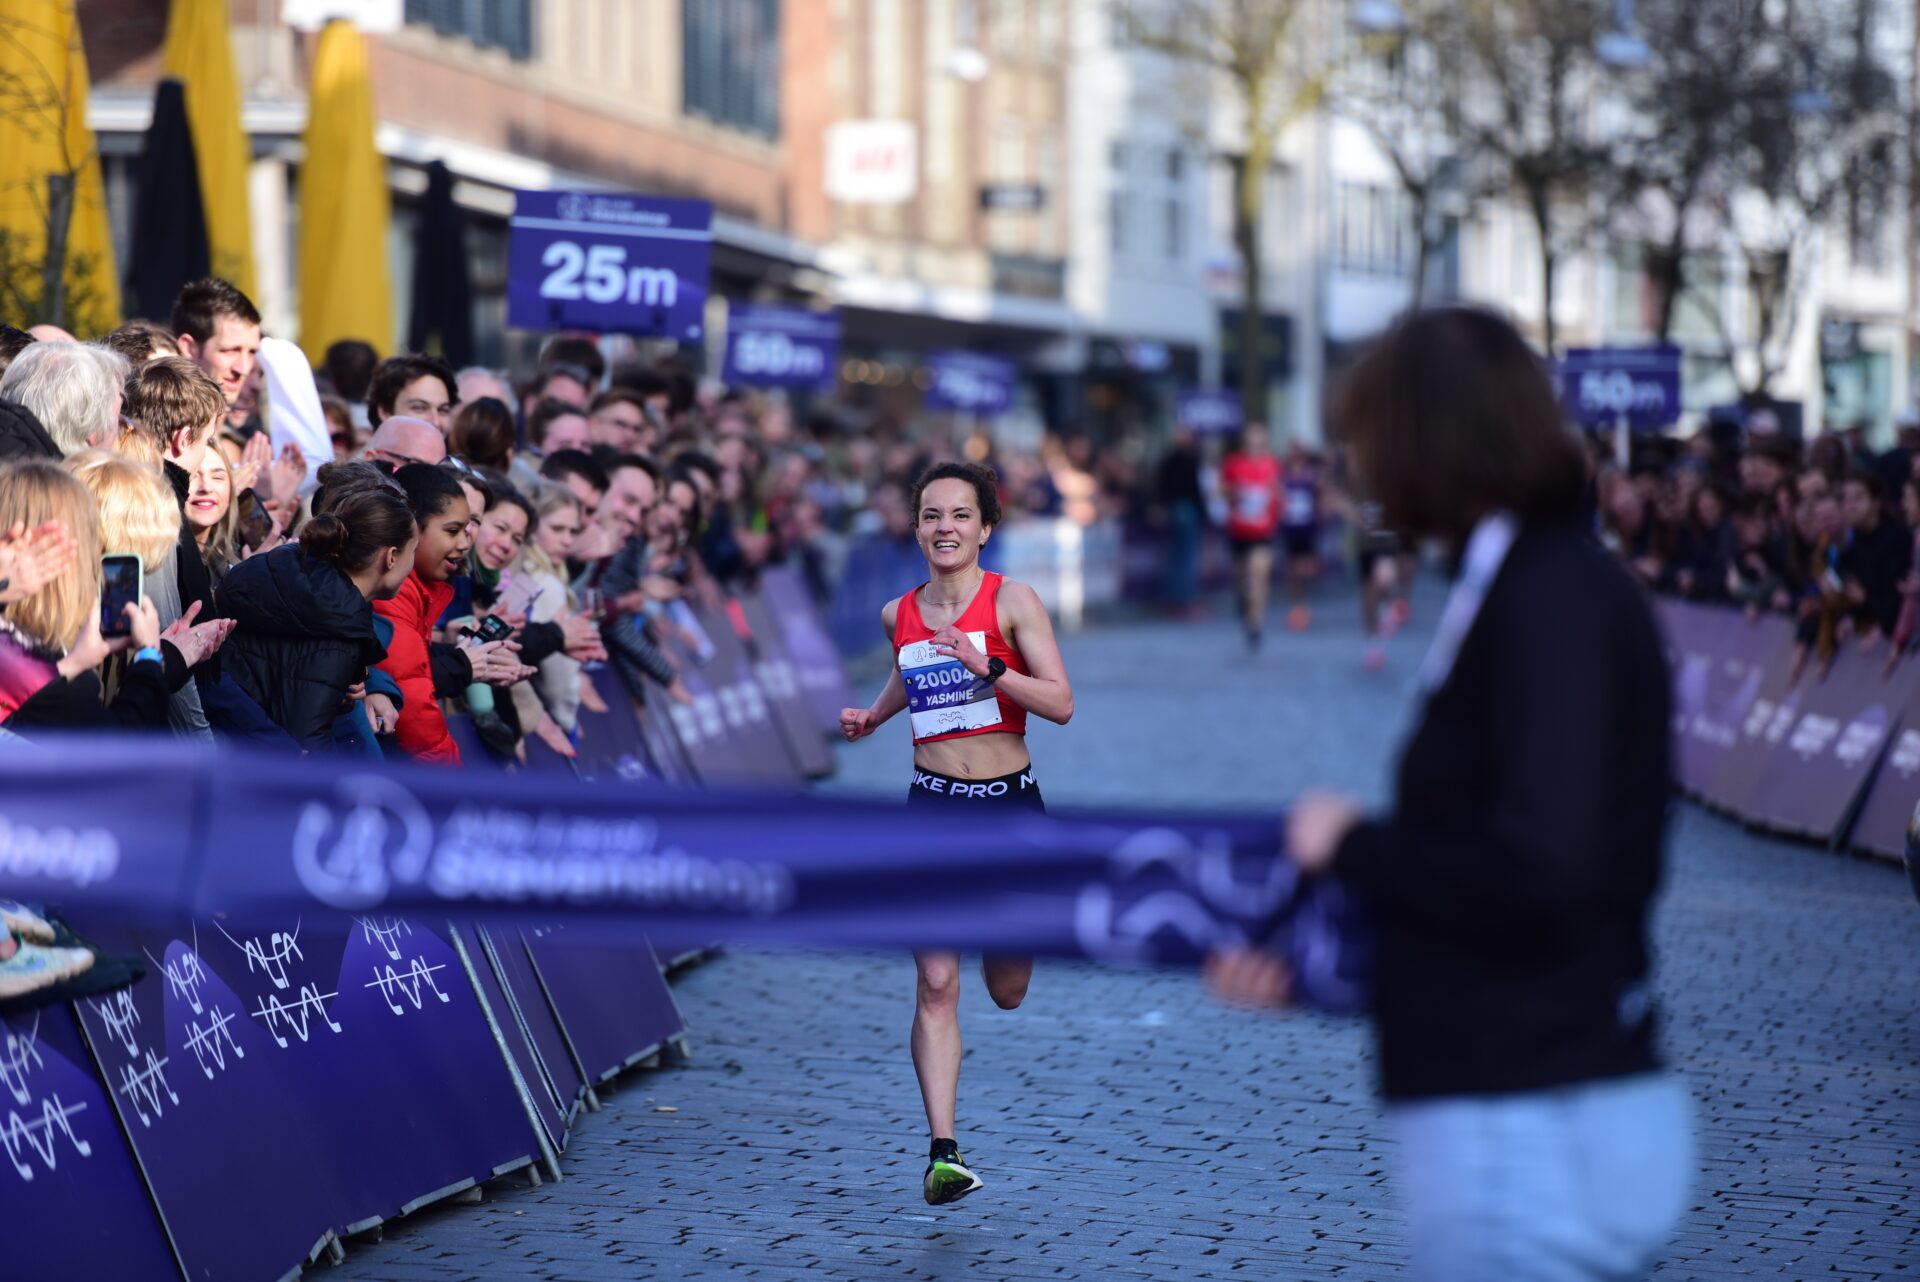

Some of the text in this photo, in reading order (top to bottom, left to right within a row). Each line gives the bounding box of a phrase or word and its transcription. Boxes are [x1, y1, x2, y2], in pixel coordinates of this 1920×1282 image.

[540, 240, 678, 306] 25m
[1580, 369, 1665, 411] 50m
[915, 668, 976, 690] 20004
[926, 689, 974, 706] YASMINE
[949, 782, 1008, 798] PRO
